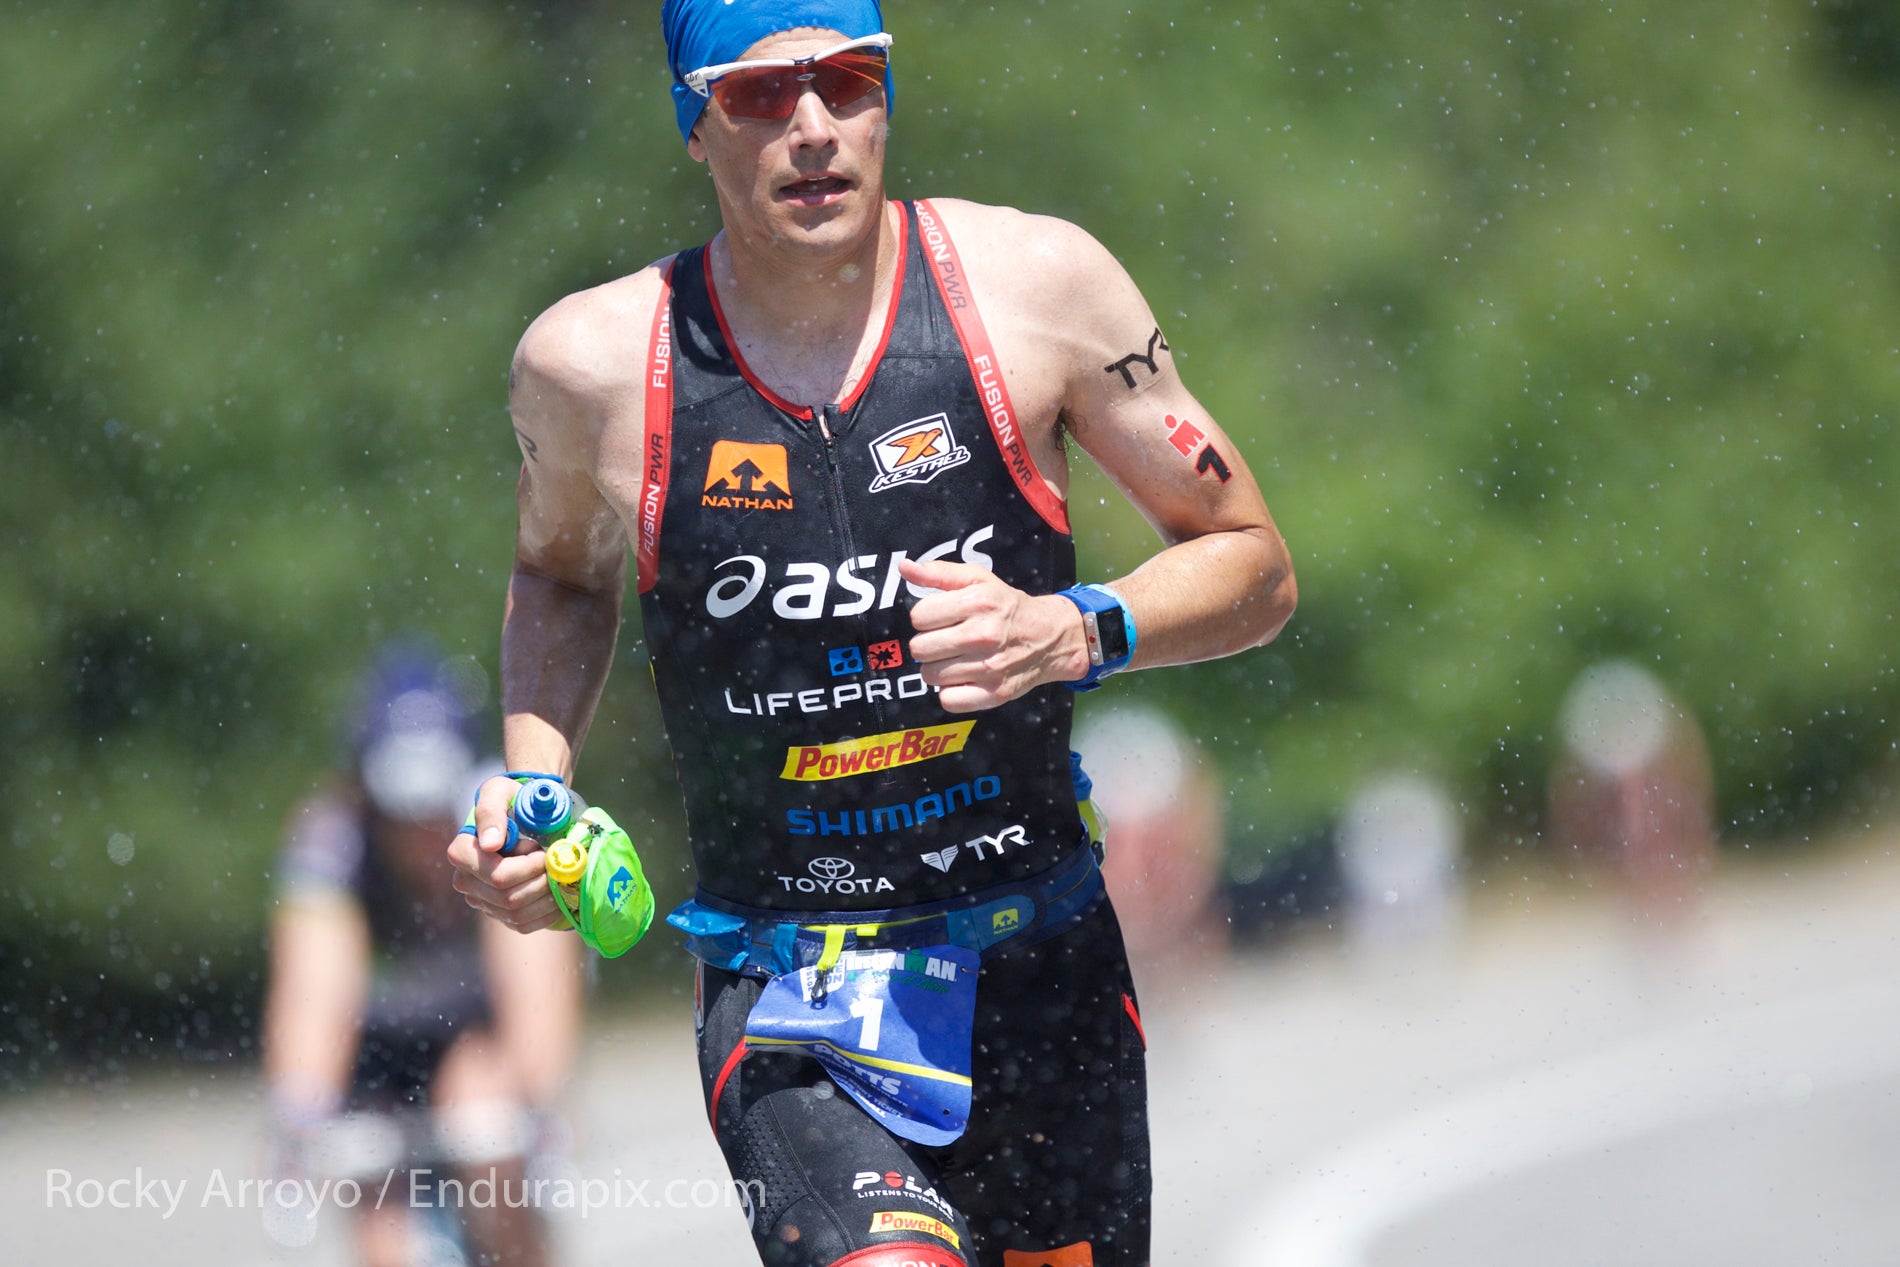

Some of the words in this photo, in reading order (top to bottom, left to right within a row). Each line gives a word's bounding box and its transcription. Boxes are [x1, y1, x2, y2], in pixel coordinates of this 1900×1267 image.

[873, 450, 967, 489] KESTREL
[701, 495, 793, 510] NATHAN
[724, 673, 940, 716] LIFEPRO
[795, 730, 957, 779] PowerBar
[786, 775, 1001, 837] SHIMANO
[965, 824, 1031, 862] TYR
[777, 876, 896, 895] TOYOTA
[850, 997, 883, 1051] 1
[852, 1171, 954, 1218] POLAR
[857, 1190, 902, 1199] LISTENS
[903, 1191, 916, 1199] TO
[879, 1212, 954, 1243] PowerBar
